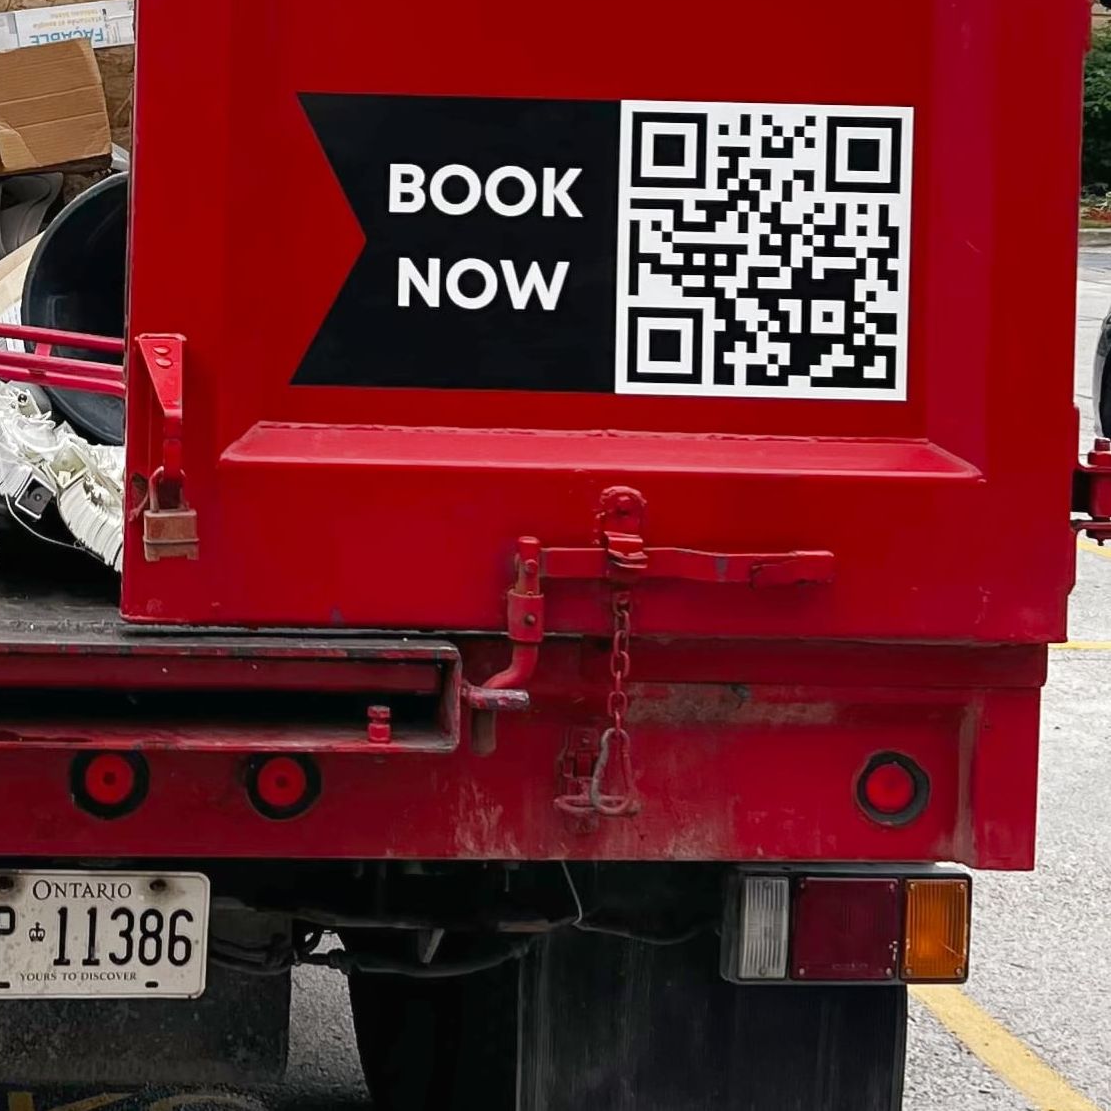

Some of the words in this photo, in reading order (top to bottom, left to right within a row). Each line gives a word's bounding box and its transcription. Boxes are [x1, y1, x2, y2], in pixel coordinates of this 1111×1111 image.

[388, 163, 584, 218] BOOK
[397, 257, 570, 311] NOW
[20, 972, 57, 982] YOURS
[62, 972, 78, 981] TO
[80, 971, 137, 982] DISCOVER
